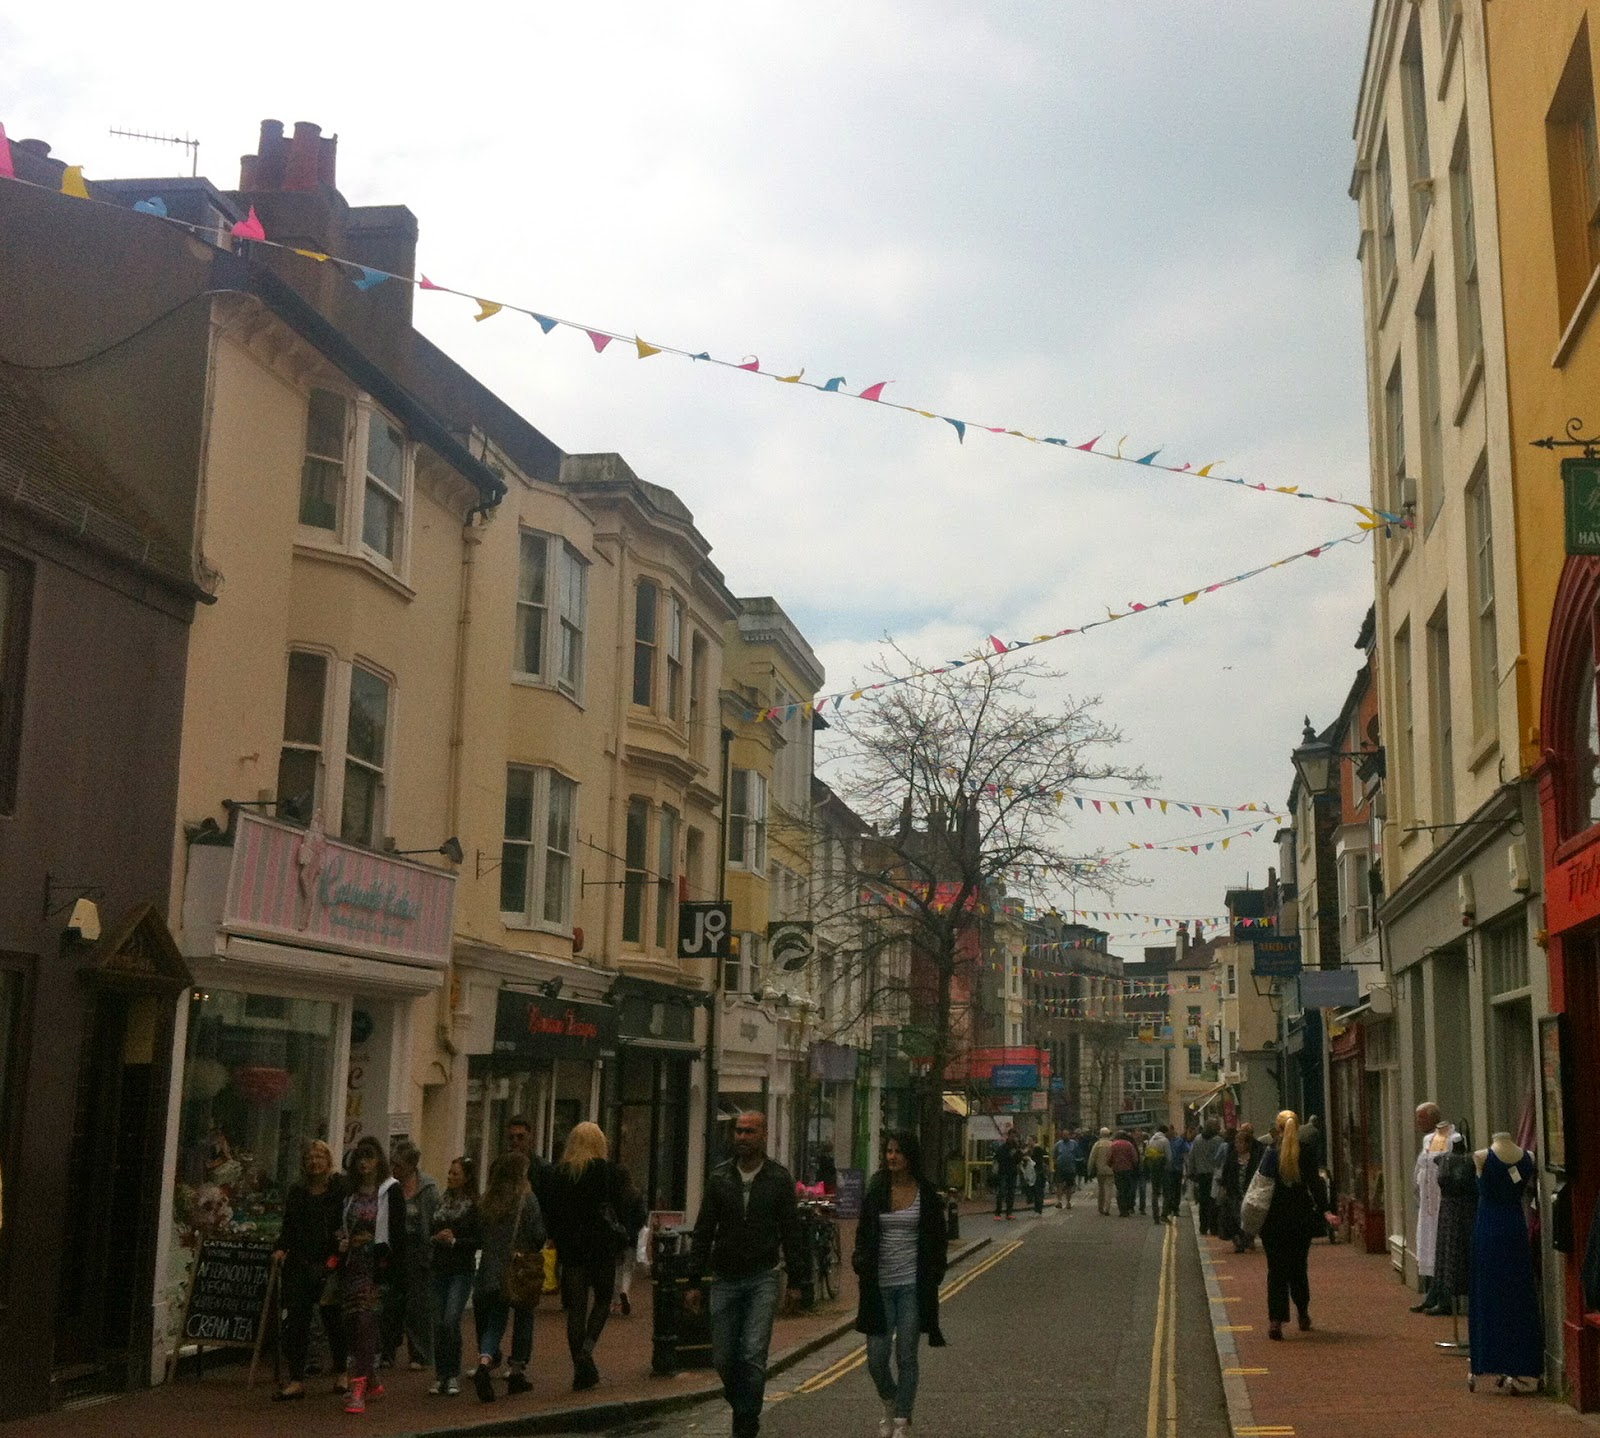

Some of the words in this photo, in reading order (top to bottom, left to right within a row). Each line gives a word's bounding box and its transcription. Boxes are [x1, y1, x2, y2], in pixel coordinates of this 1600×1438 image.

[682, 909, 726, 953] JOY
[203, 1240, 244, 1249] CATWALK
[197, 1261, 254, 1283] AFTERNOON
[253, 1265, 269, 1286] TEA
[187, 1312, 230, 1339] CREAM
[232, 1316, 254, 1341] TEA
